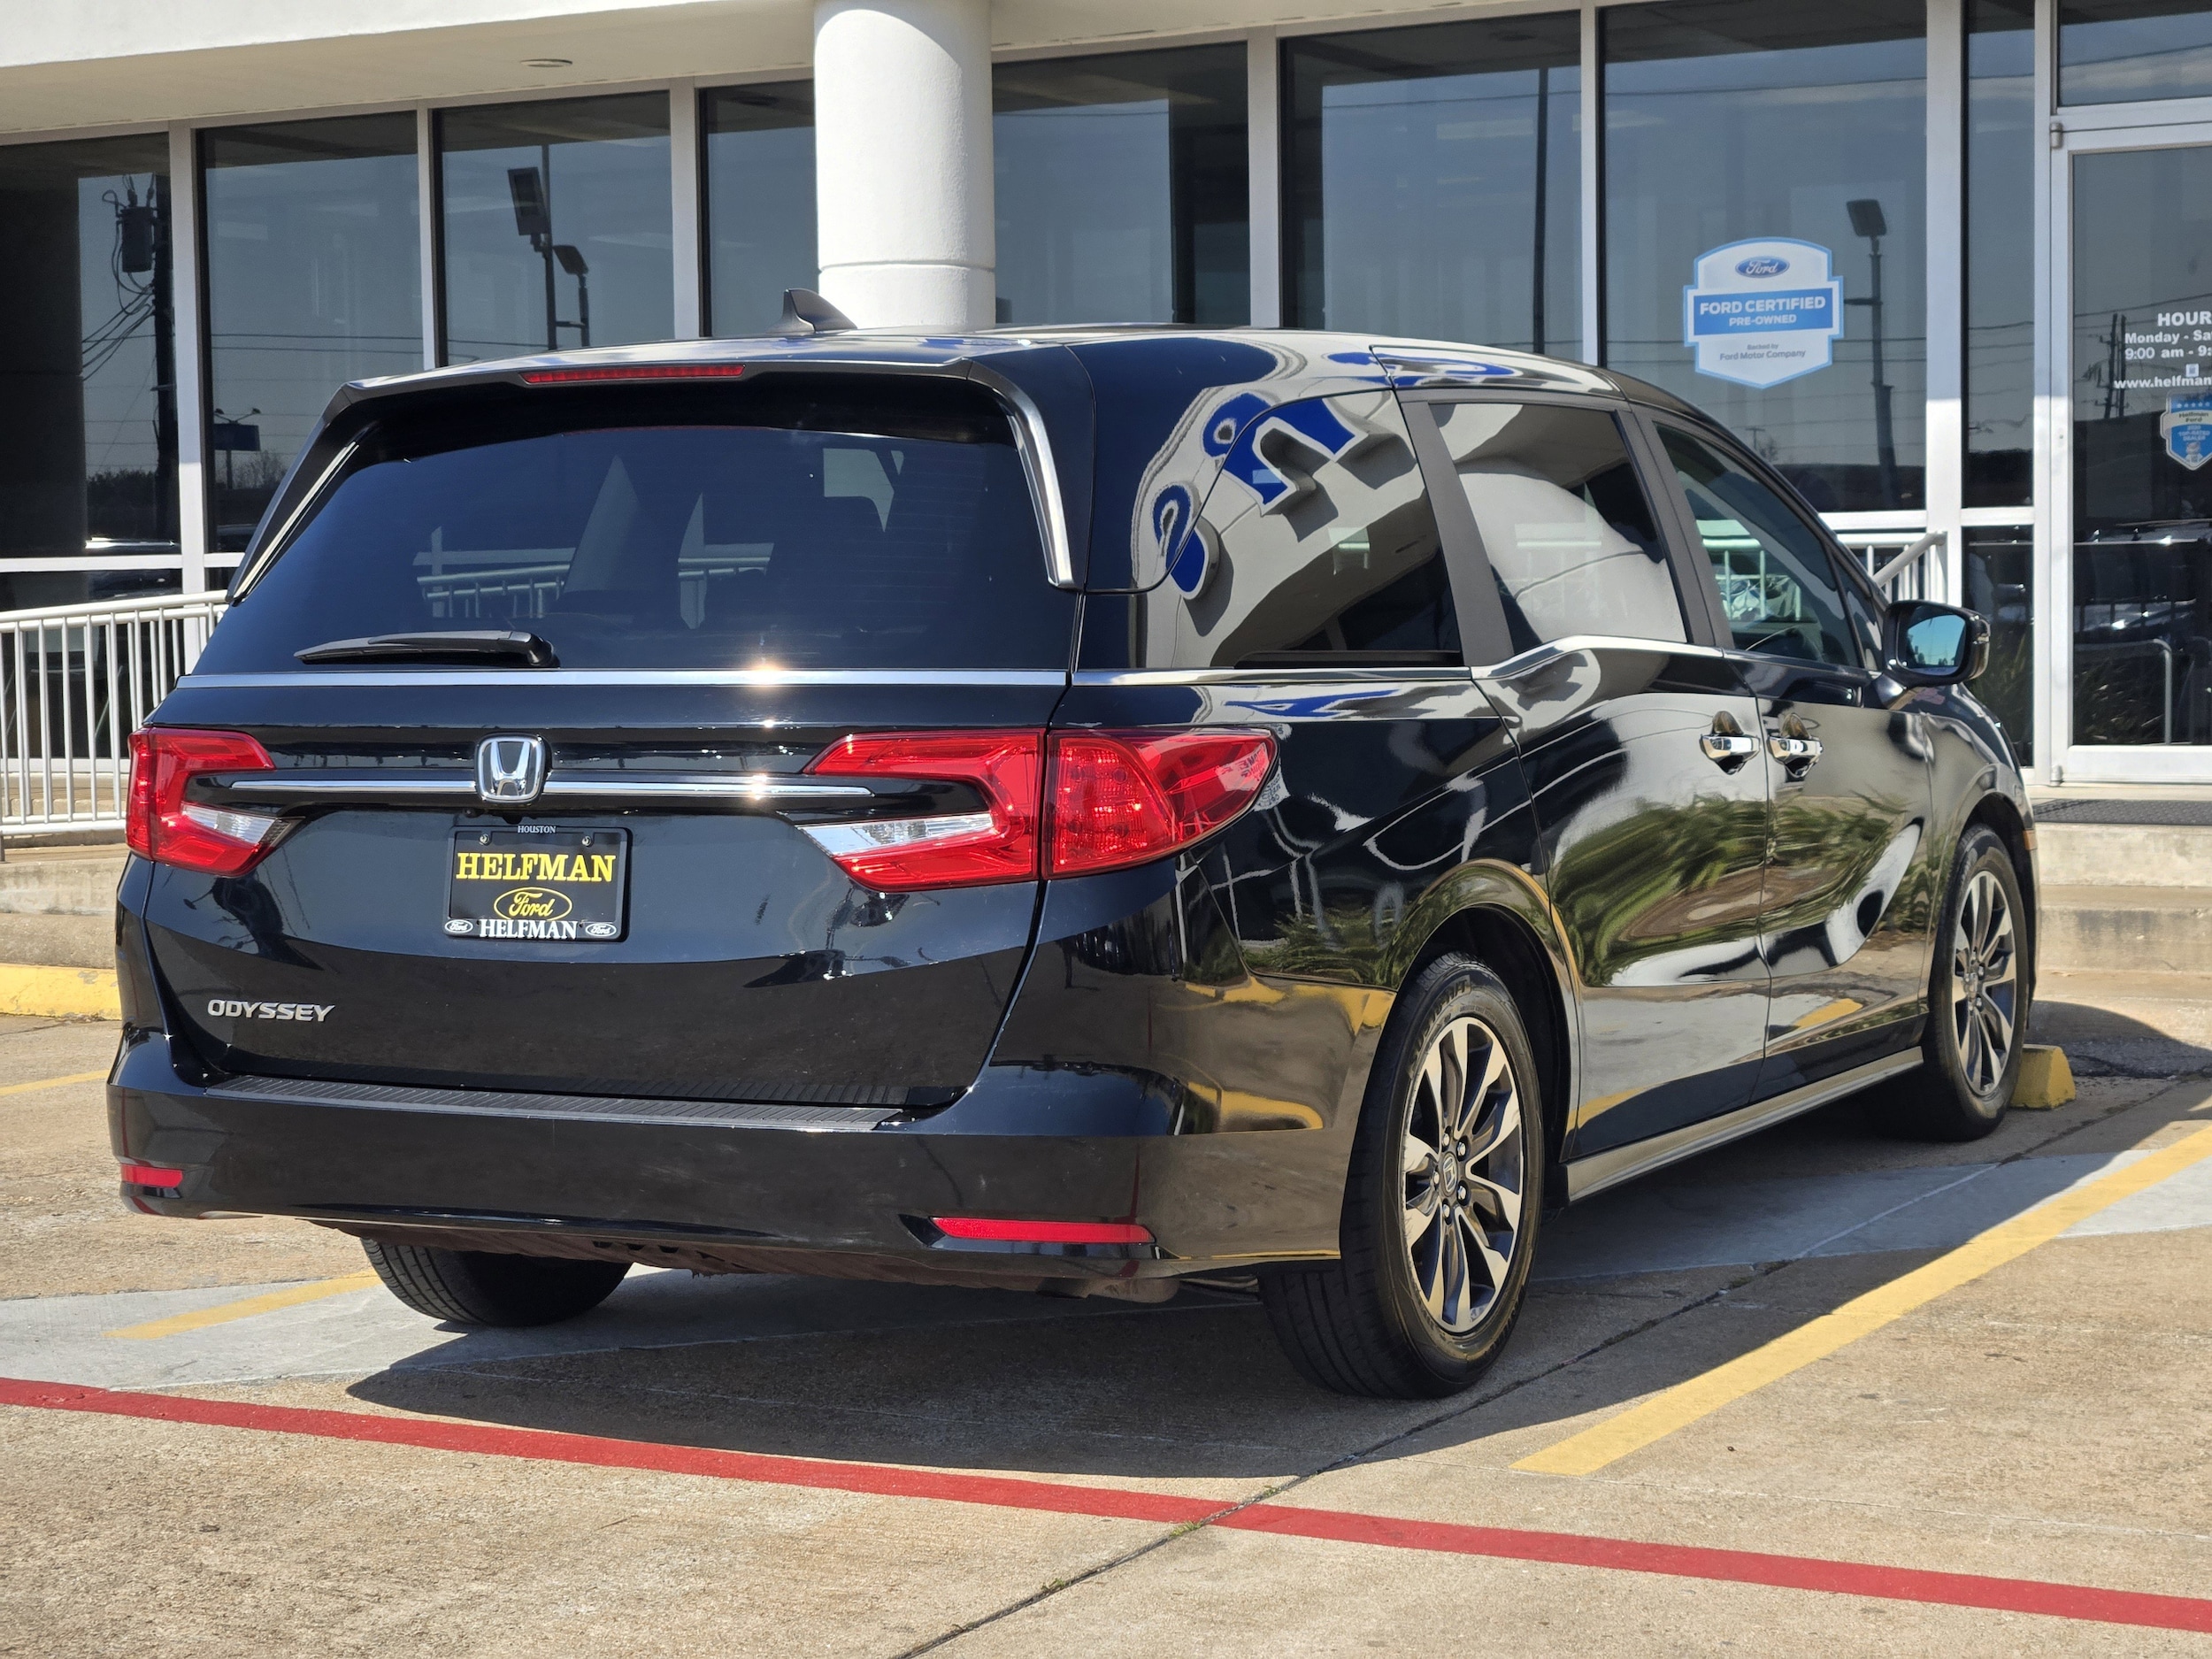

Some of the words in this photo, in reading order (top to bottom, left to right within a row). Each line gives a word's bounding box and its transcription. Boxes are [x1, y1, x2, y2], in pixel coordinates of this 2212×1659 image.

[1746, 259, 1778, 274] Ford
[1700, 301, 1742, 315] FORD
[1745, 296, 1825, 311] CERTIFIED
[1729, 314, 1797, 326] PRE-OWNED
[2124, 331, 2180, 345] Monday
[2193, 329, 2212, 342] Sa
[2124, 346, 2155, 360] 9:00
[2161, 348, 2185, 358] am
[2114, 375, 2212, 388] www.helfman
[455, 852, 617, 883] HELFMAN
[508, 891, 556, 917] Ford
[479, 918, 579, 941] HELFMAN
[207, 999, 336, 1023] ODYSSEY
